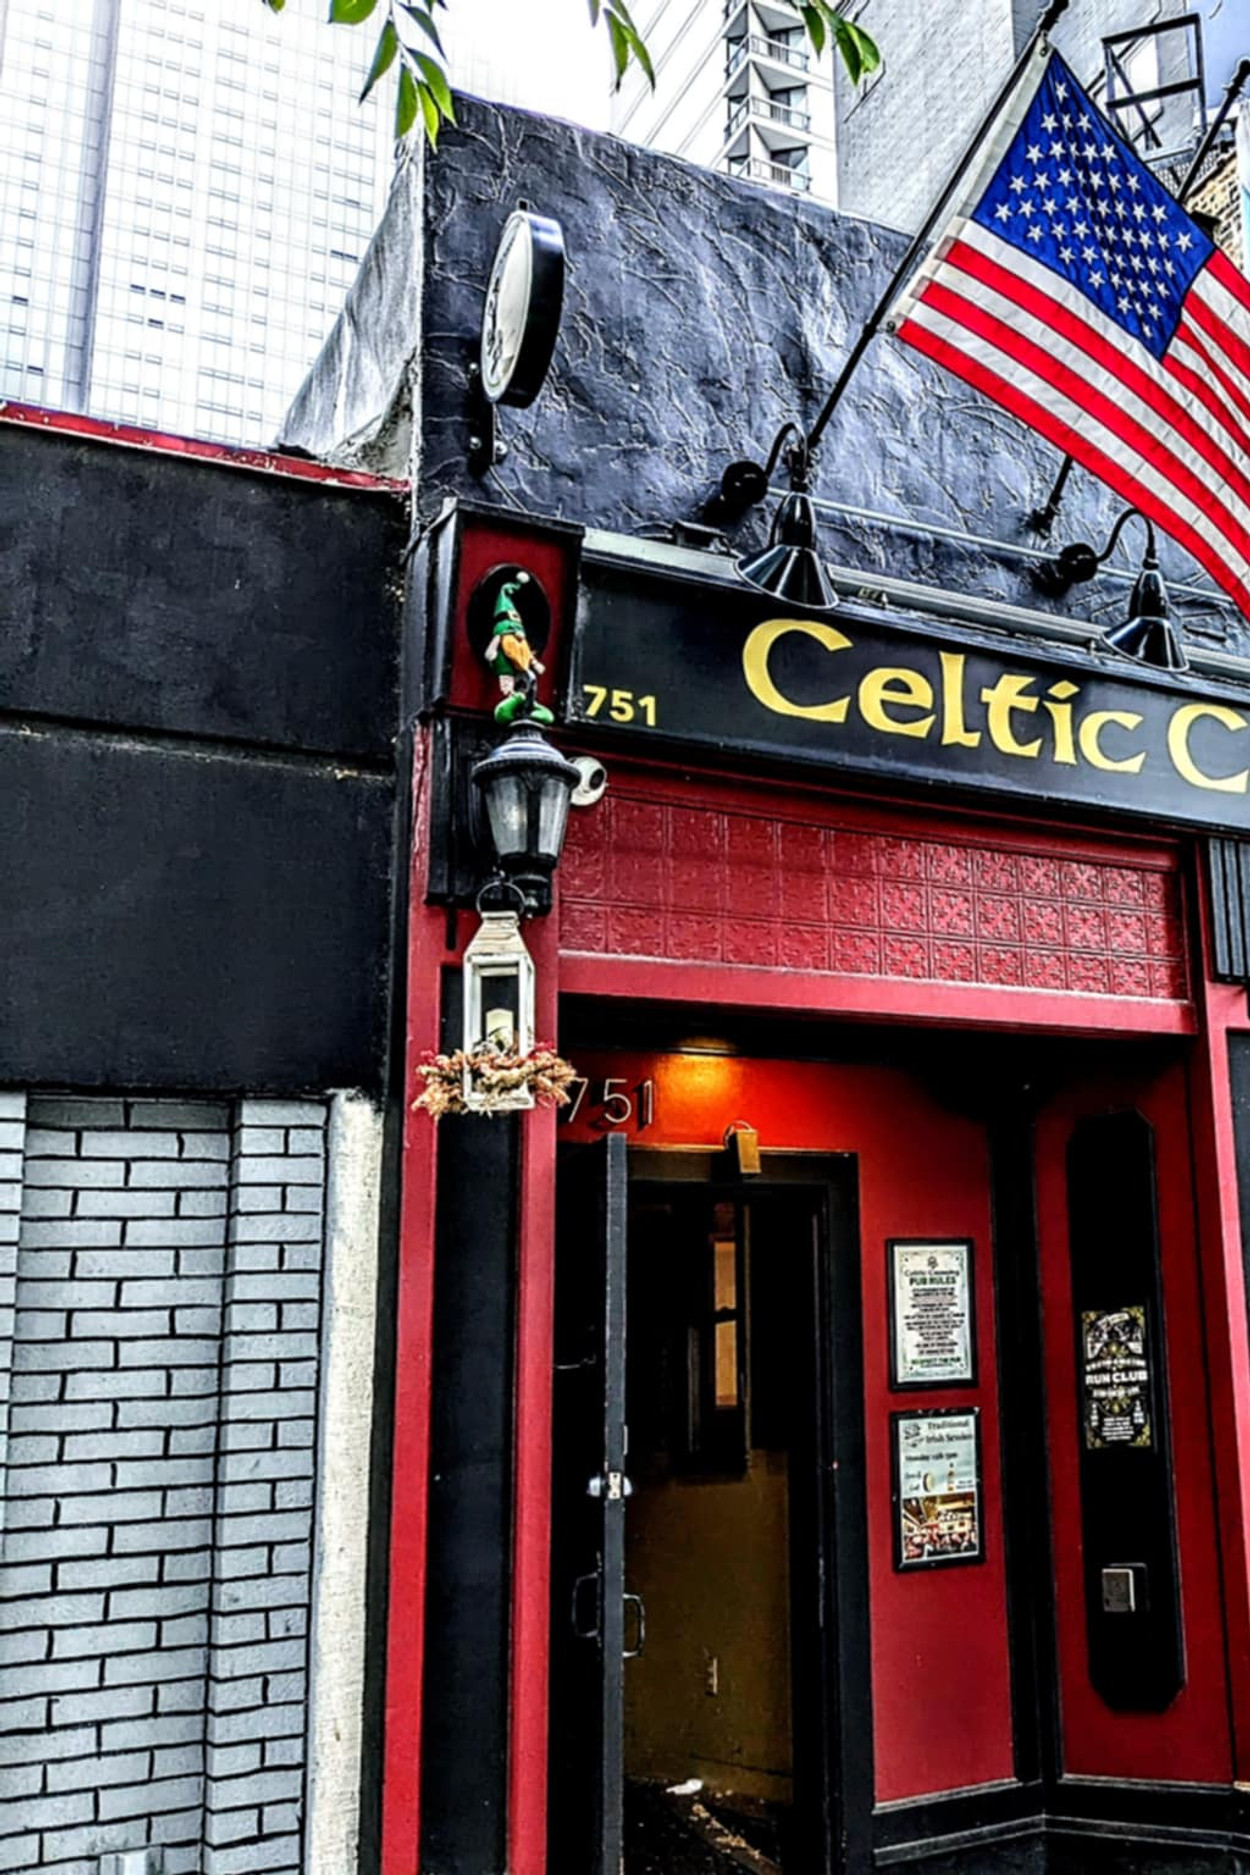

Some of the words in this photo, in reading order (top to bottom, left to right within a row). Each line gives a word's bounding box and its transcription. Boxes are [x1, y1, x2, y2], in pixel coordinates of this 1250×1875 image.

[583, 684, 657, 728] 751
[742, 619, 1146, 774] Celtic
[569, 1077, 653, 1125] 751
[1112, 1370, 1148, 1384] CLUB
